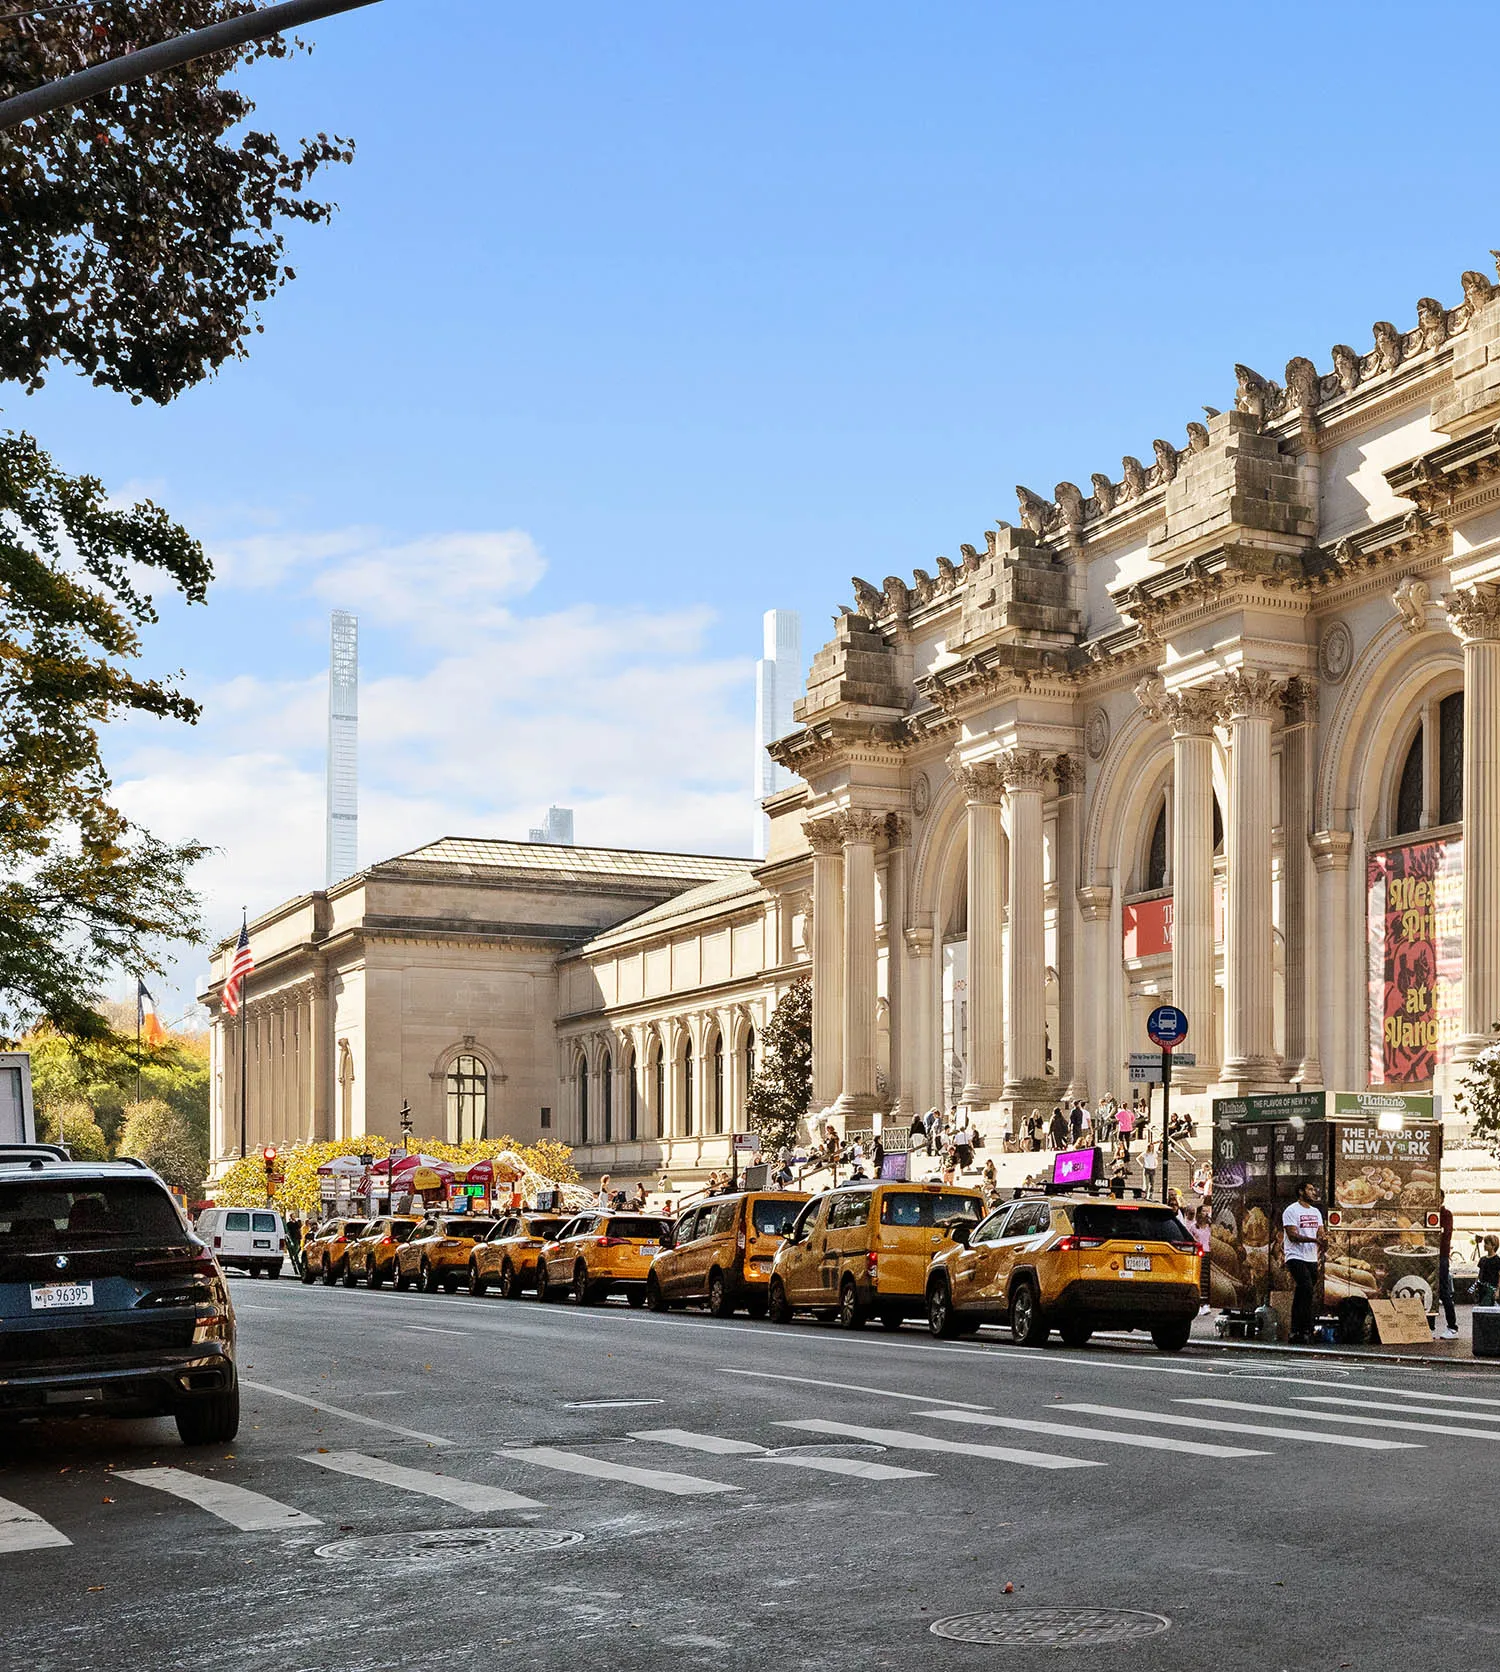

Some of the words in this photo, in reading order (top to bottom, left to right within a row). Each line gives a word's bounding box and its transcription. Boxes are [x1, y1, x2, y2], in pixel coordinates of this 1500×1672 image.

[1406, 982, 1427, 1013] at
[1253, 1100, 1263, 1108] THE
[1263, 1099, 1283, 1108] FLAVOR
[1283, 1098, 1291, 1106] OF
[1291, 1098, 1303, 1106] NEW
[1304, 1096, 1318, 1105] YRK
[1357, 1094, 1406, 1109] Nathan's
[1342, 1127, 1366, 1138] THE
[1368, 1129, 1412, 1140] FLAVOR
[1415, 1130, 1431, 1140] OF
[1341, 1139, 1381, 1154] NEW
[56, 1288, 88, 1302] 96395
